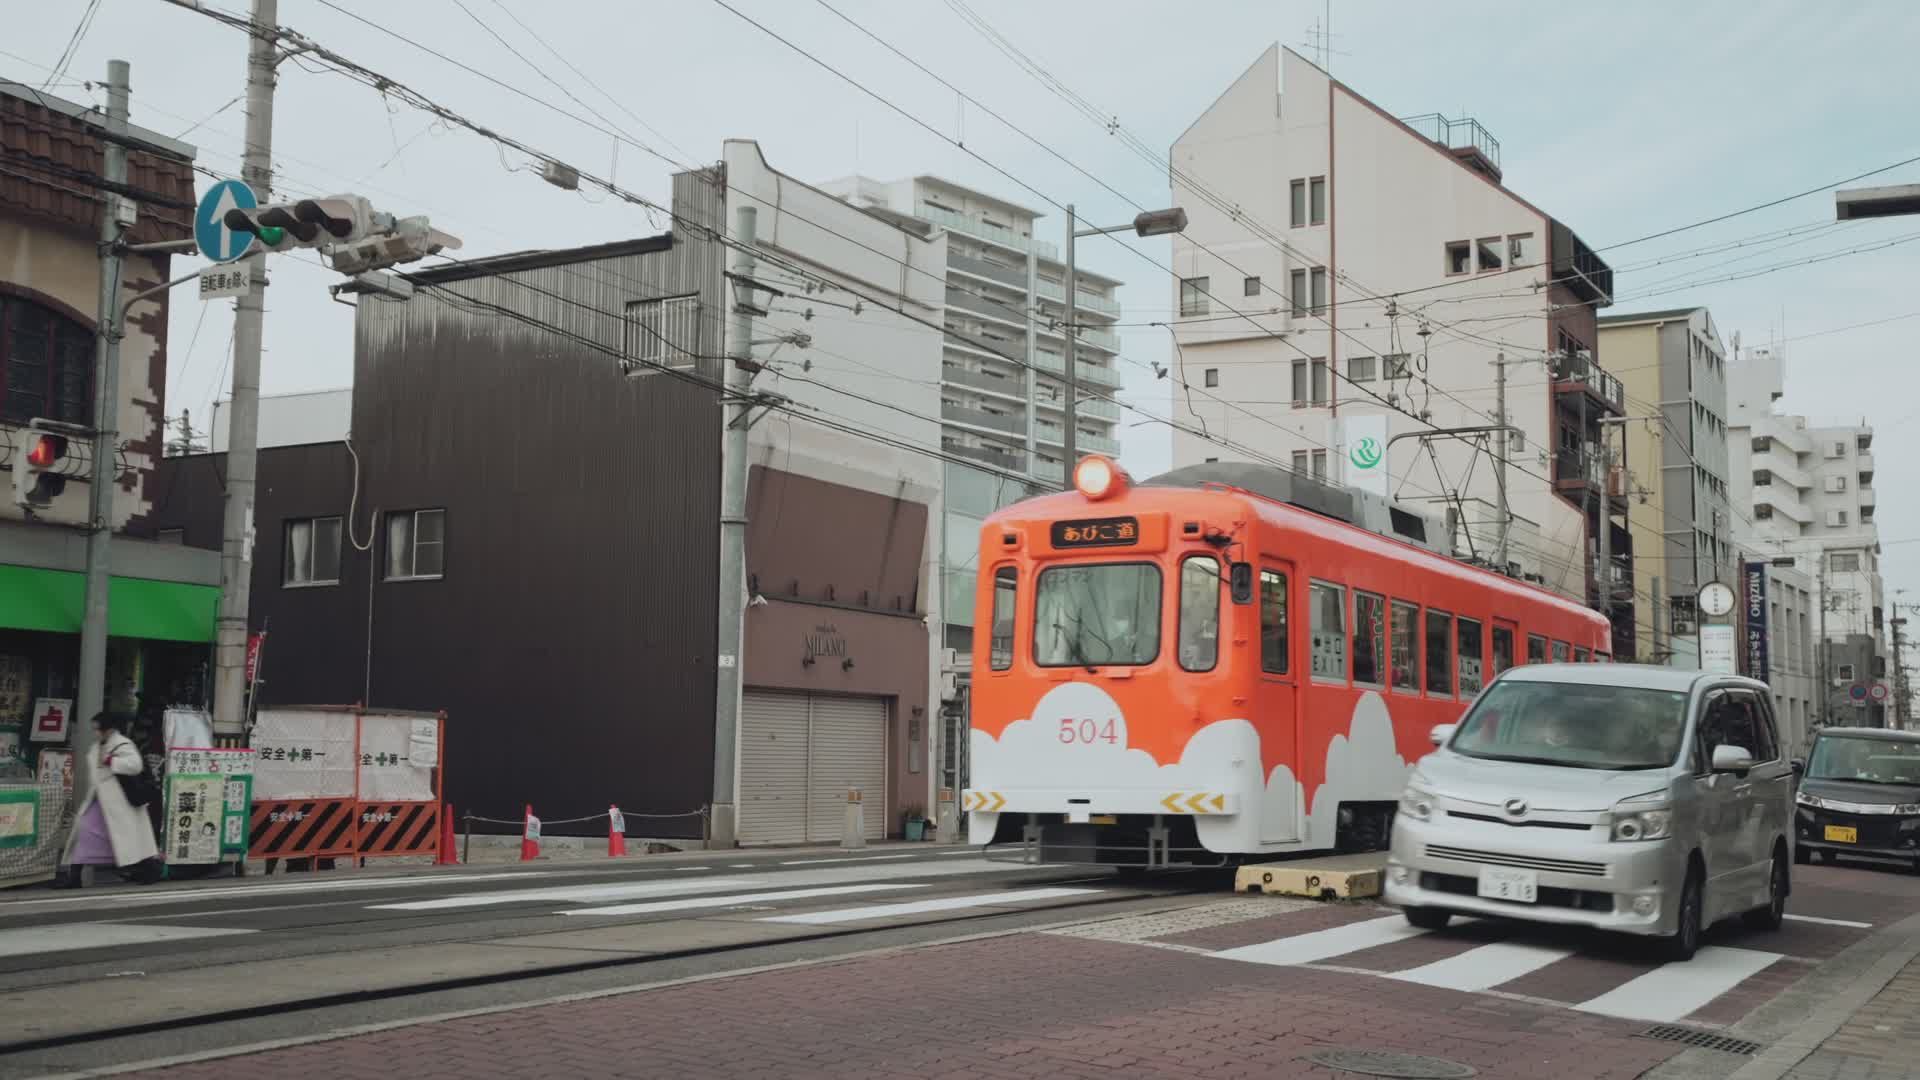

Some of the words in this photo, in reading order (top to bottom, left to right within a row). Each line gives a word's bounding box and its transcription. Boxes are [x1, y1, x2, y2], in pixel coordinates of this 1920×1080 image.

[201, 271, 248, 293] 自転車を除く
[1063, 522, 1136, 541] あびこ道
[1312, 655, 1343, 674] EXIT
[1058, 718, 1119, 745] 504
